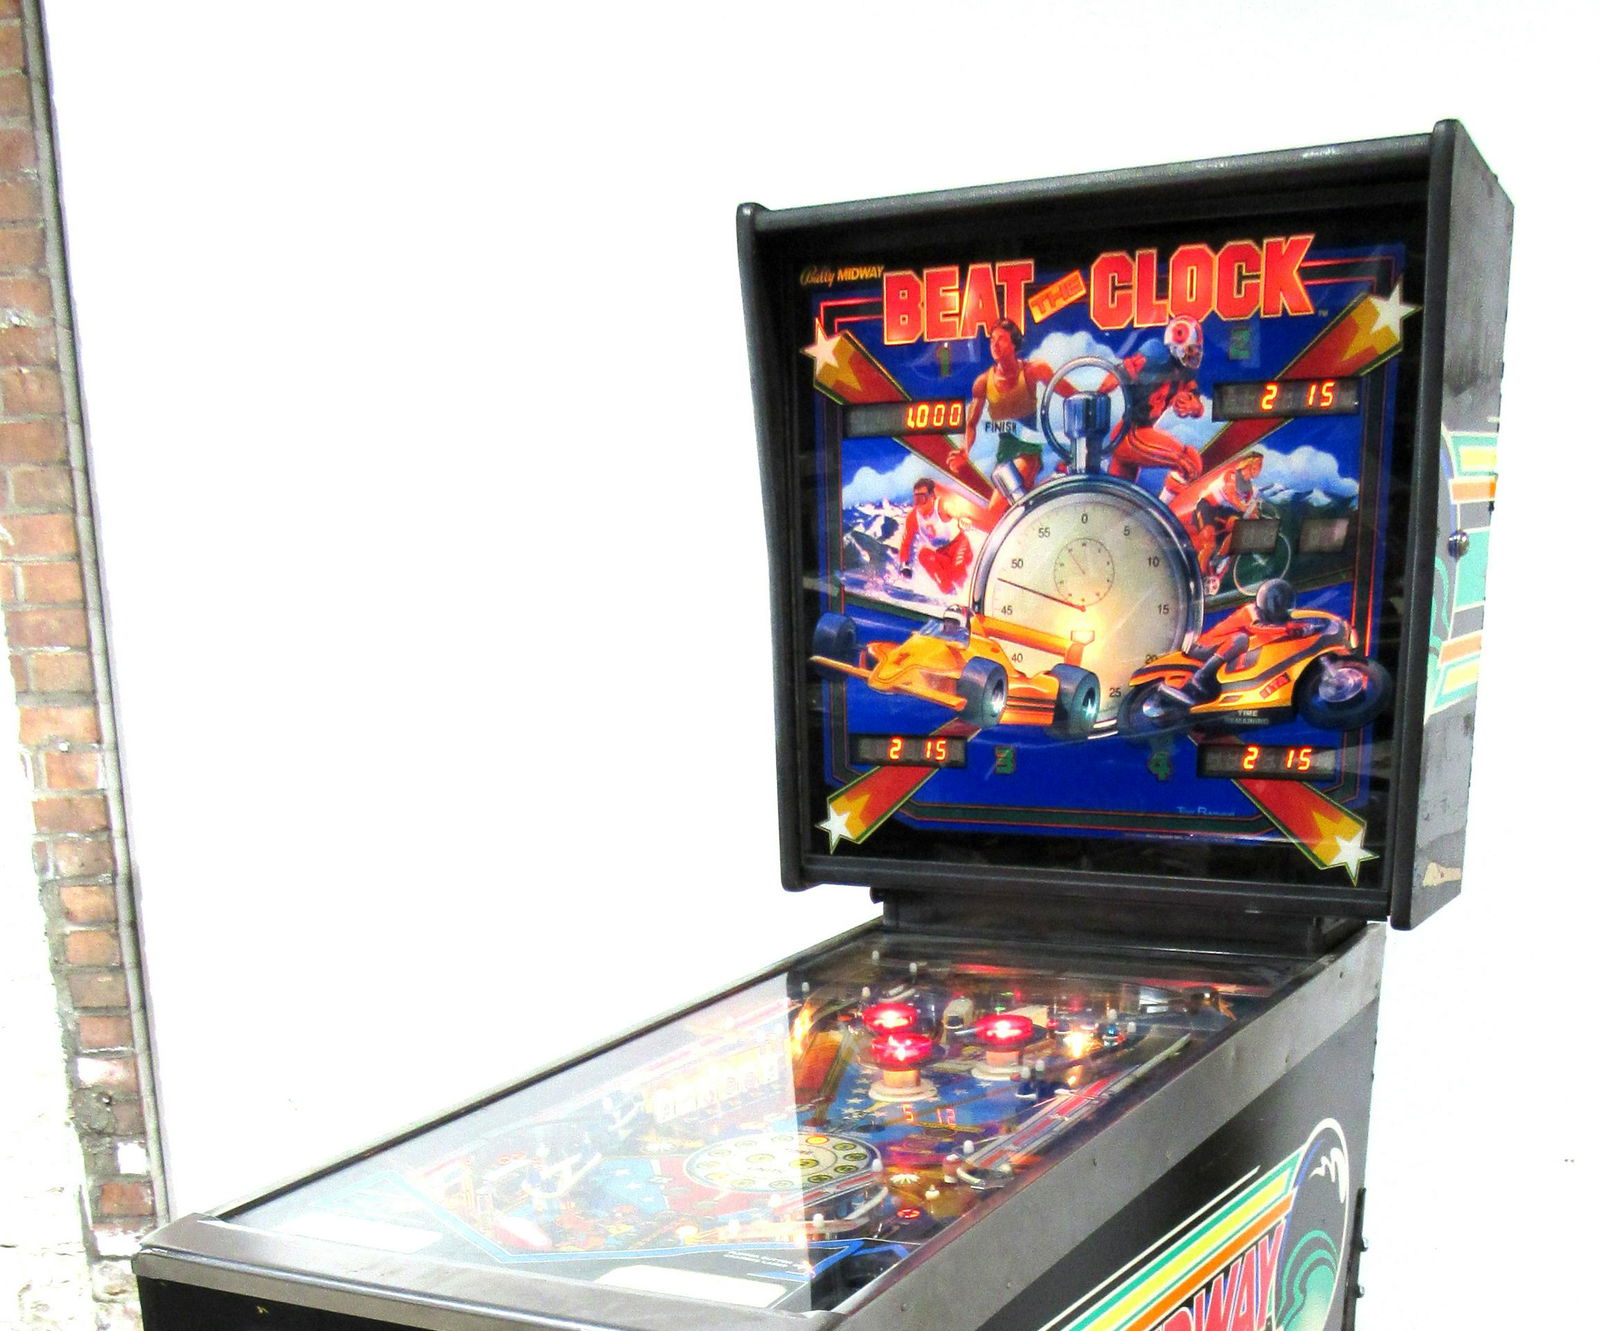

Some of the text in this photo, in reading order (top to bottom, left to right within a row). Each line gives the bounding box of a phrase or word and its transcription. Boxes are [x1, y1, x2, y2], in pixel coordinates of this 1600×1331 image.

[837, 264, 885, 282] MIDWAY
[883, 258, 1034, 345] BEAT
[1030, 272, 1083, 315] THE
[1090, 233, 1316, 331] CLOCK
[1260, 380, 1336, 411] 2 15
[985, 421, 1017, 433] FINISH
[1081, 513, 1089, 525] 0
[1038, 526, 1051, 538] 55
[1123, 526, 1131, 536] 5
[1011, 558, 1024, 569] 50
[1148, 556, 1160, 568] 10
[1001, 605, 1013, 616] 45
[1158, 604, 1170, 615] 15
[1011, 653, 1024, 664] 40
[1109, 687, 1121, 698] 25
[889, 738, 947, 761] 2 15
[1243, 746, 1312, 770] 2 15
